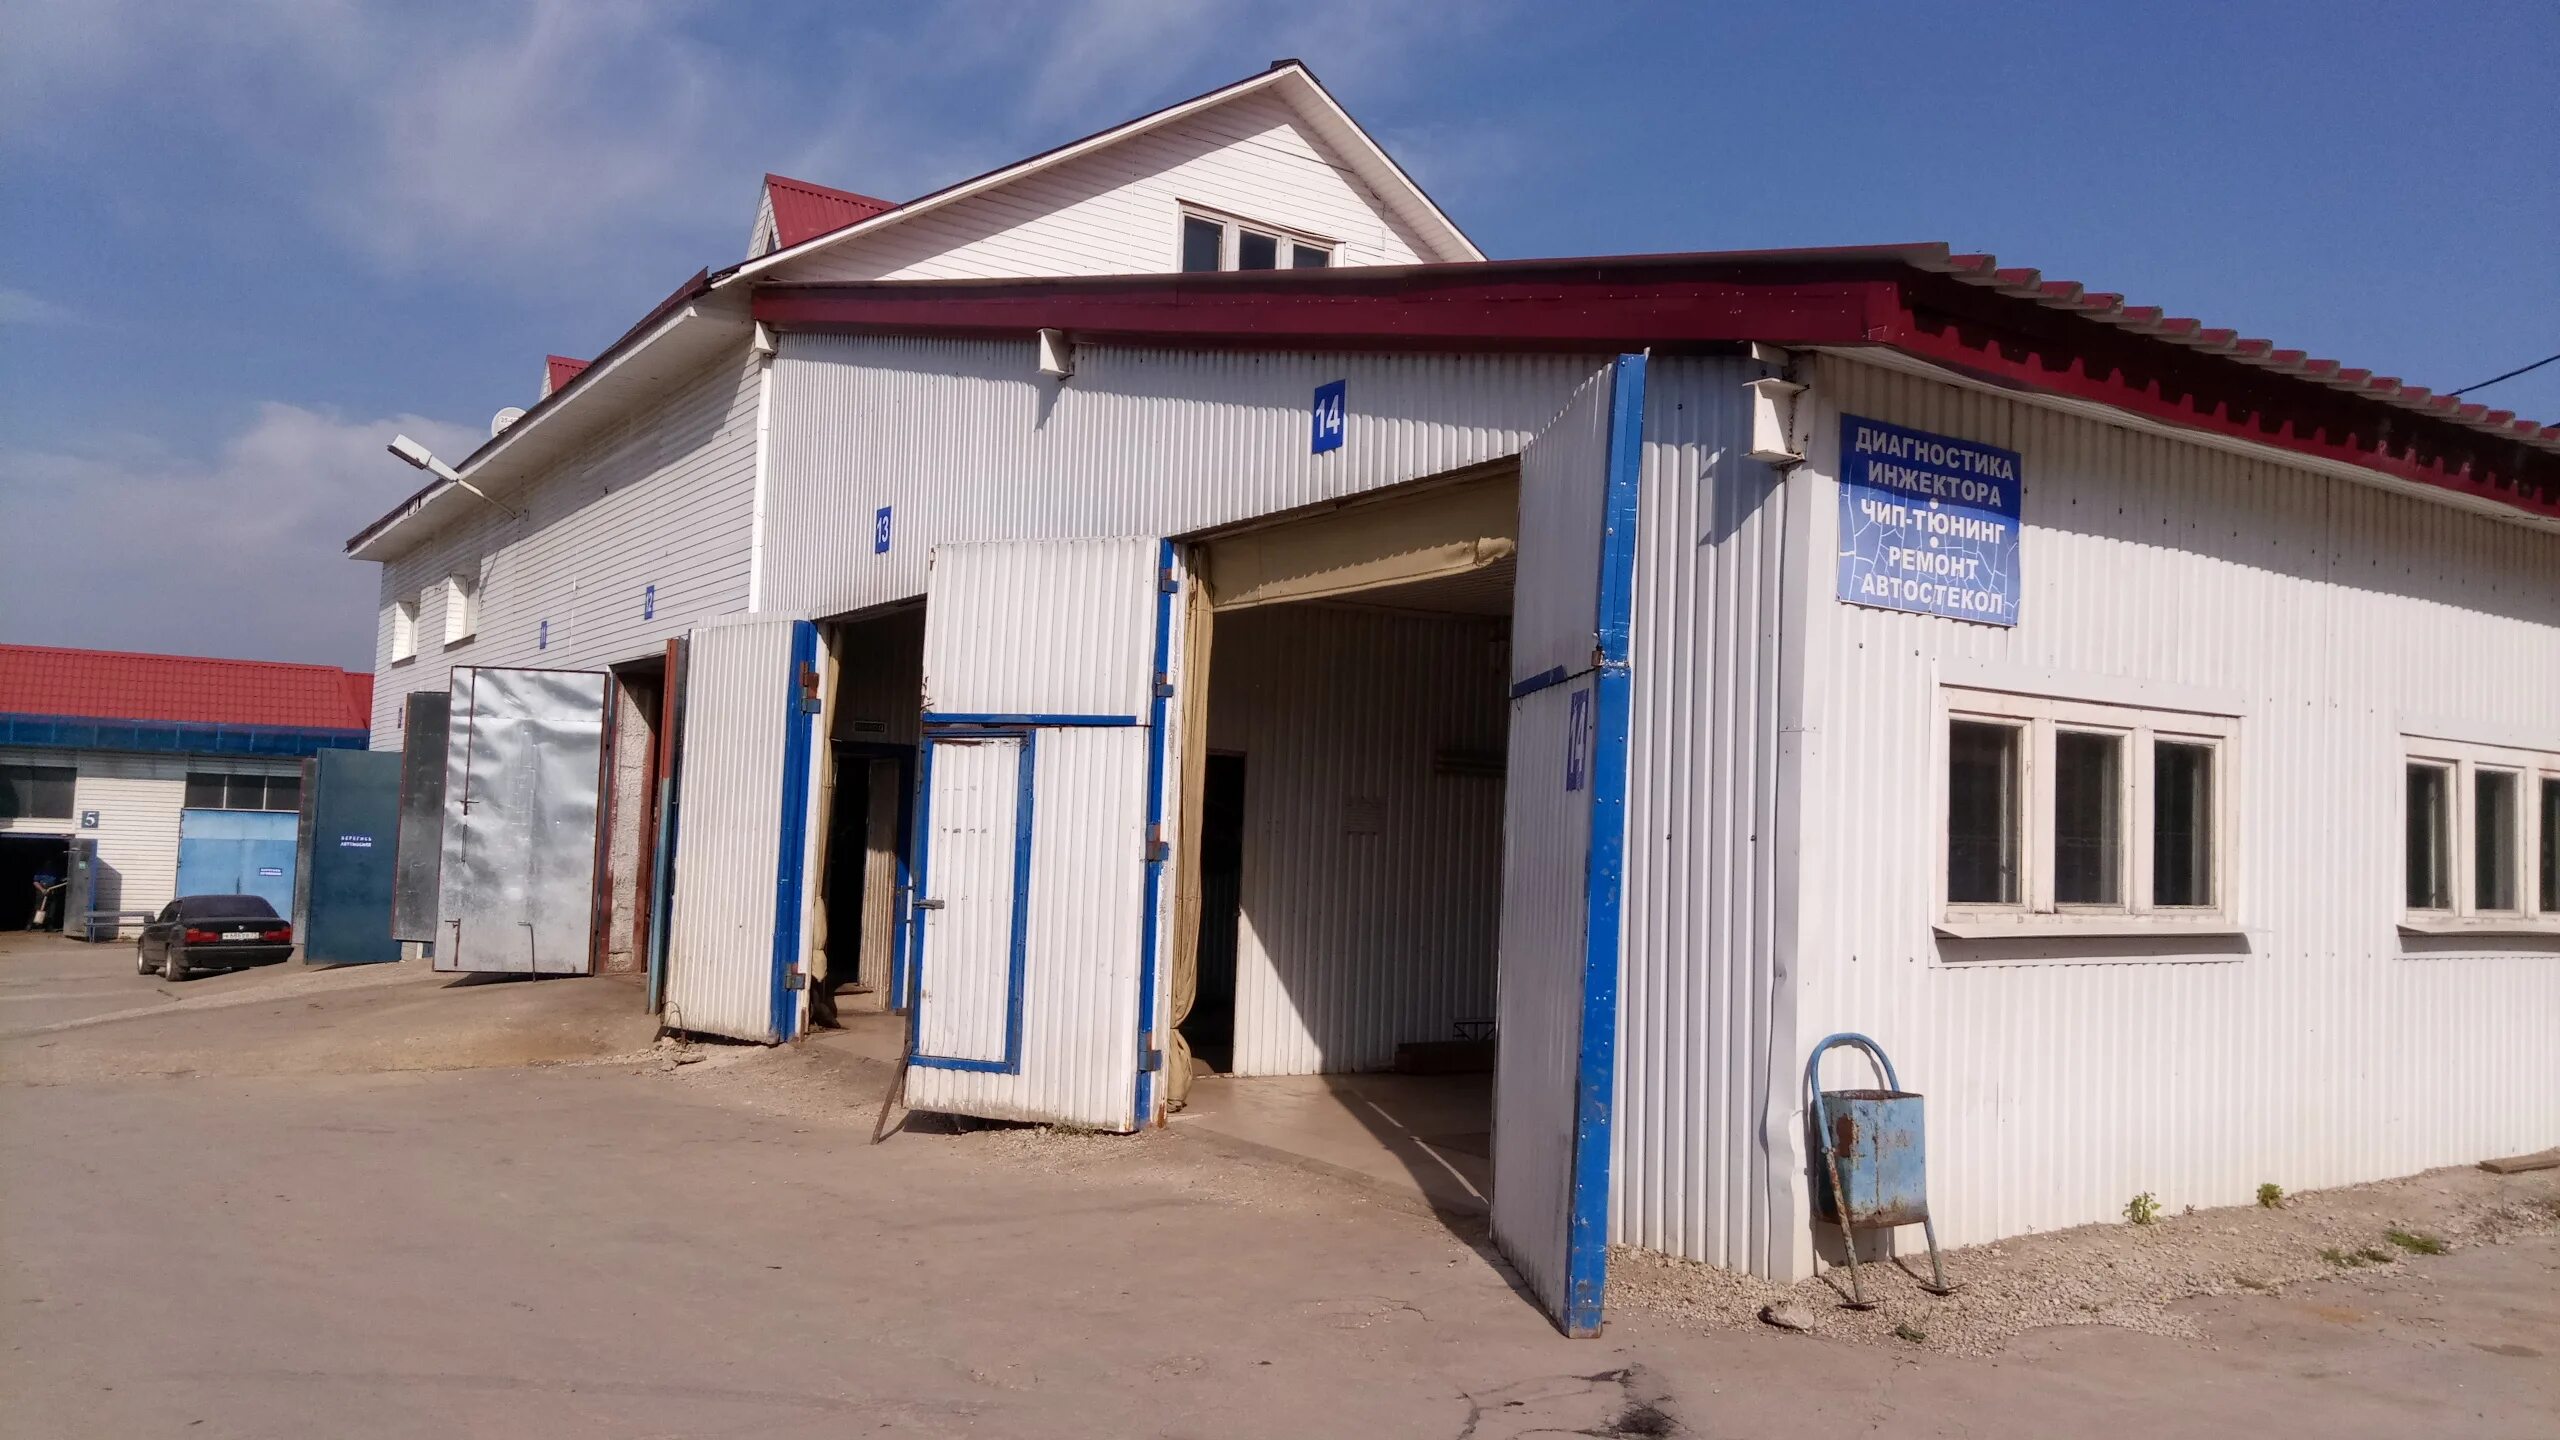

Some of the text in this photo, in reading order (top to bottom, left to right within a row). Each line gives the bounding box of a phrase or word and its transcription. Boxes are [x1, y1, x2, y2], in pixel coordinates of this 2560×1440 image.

[1315, 394, 1341, 438] 14
[1855, 426, 2014, 481] ДИАГНОСТИКА
[1868, 461, 2002, 507] ИНЖЕКТОРА
[876, 515, 889, 544] 13
[1861, 498, 2006, 544] ЧИП-ТЮНИНГ
[1889, 546, 1979, 580] РЕМОНТ
[646, 592, 653, 612] 12
[1861, 573, 2003, 615] АВТОСТЕКОЛ
[1570, 701, 1586, 773] 14
[84, 812, 96, 826] 5
